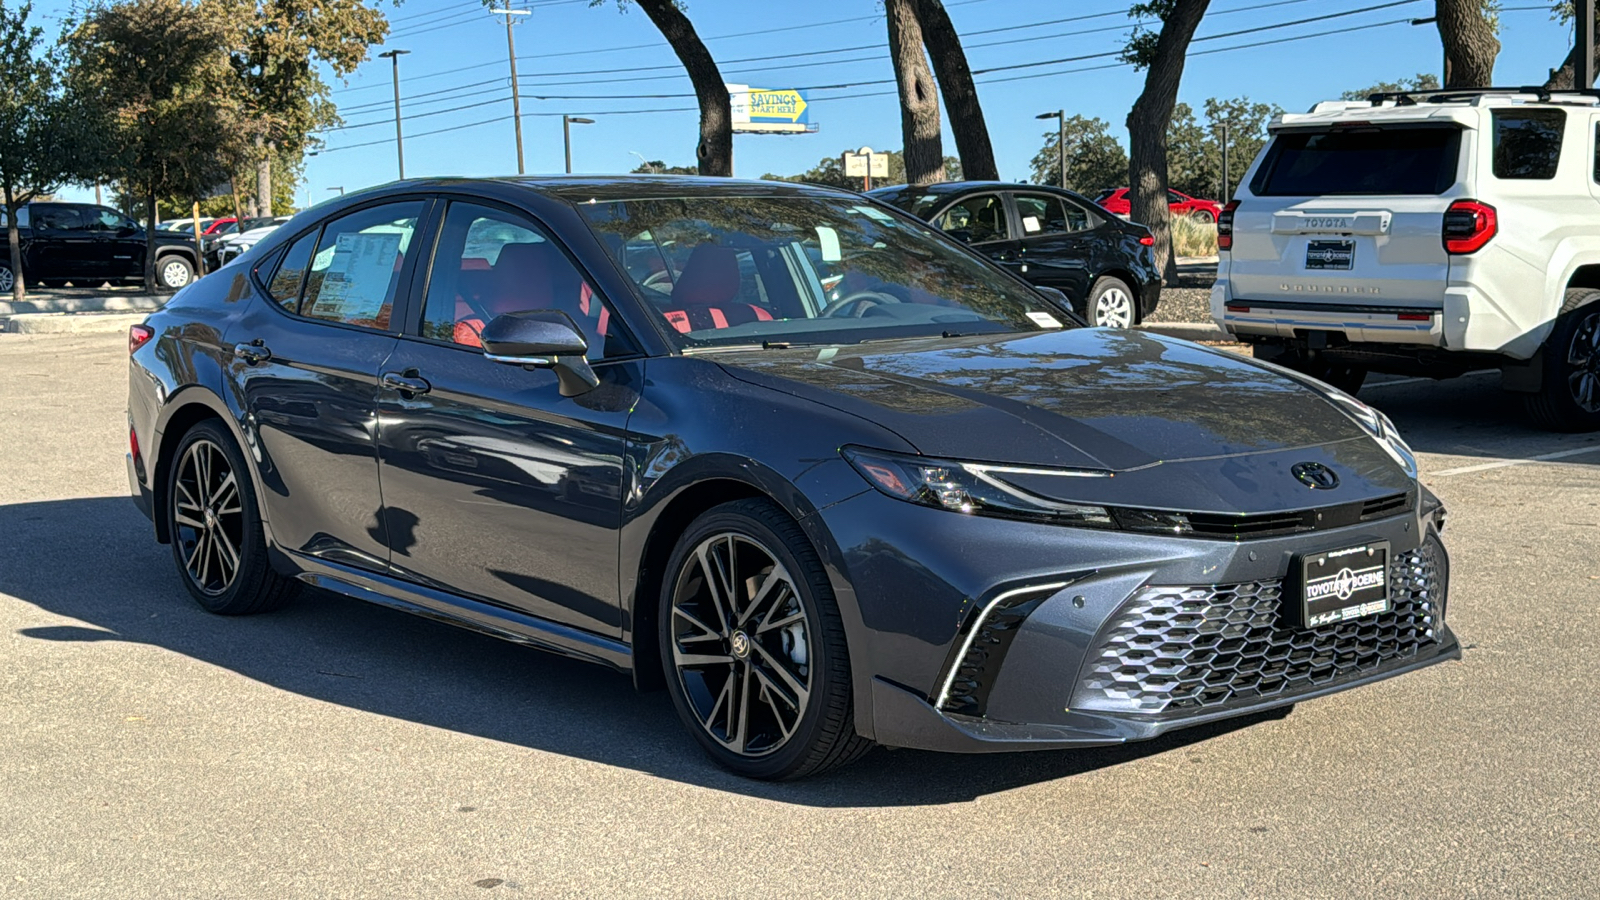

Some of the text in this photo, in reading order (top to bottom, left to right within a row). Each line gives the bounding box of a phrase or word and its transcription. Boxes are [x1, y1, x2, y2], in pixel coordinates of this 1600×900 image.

[751, 93, 796, 107] SAVINGS
[751, 105, 775, 113] START
[1304, 219, 1347, 228] TOYOTA
[1307, 571, 1384, 597] TOYOTA BOERNE
